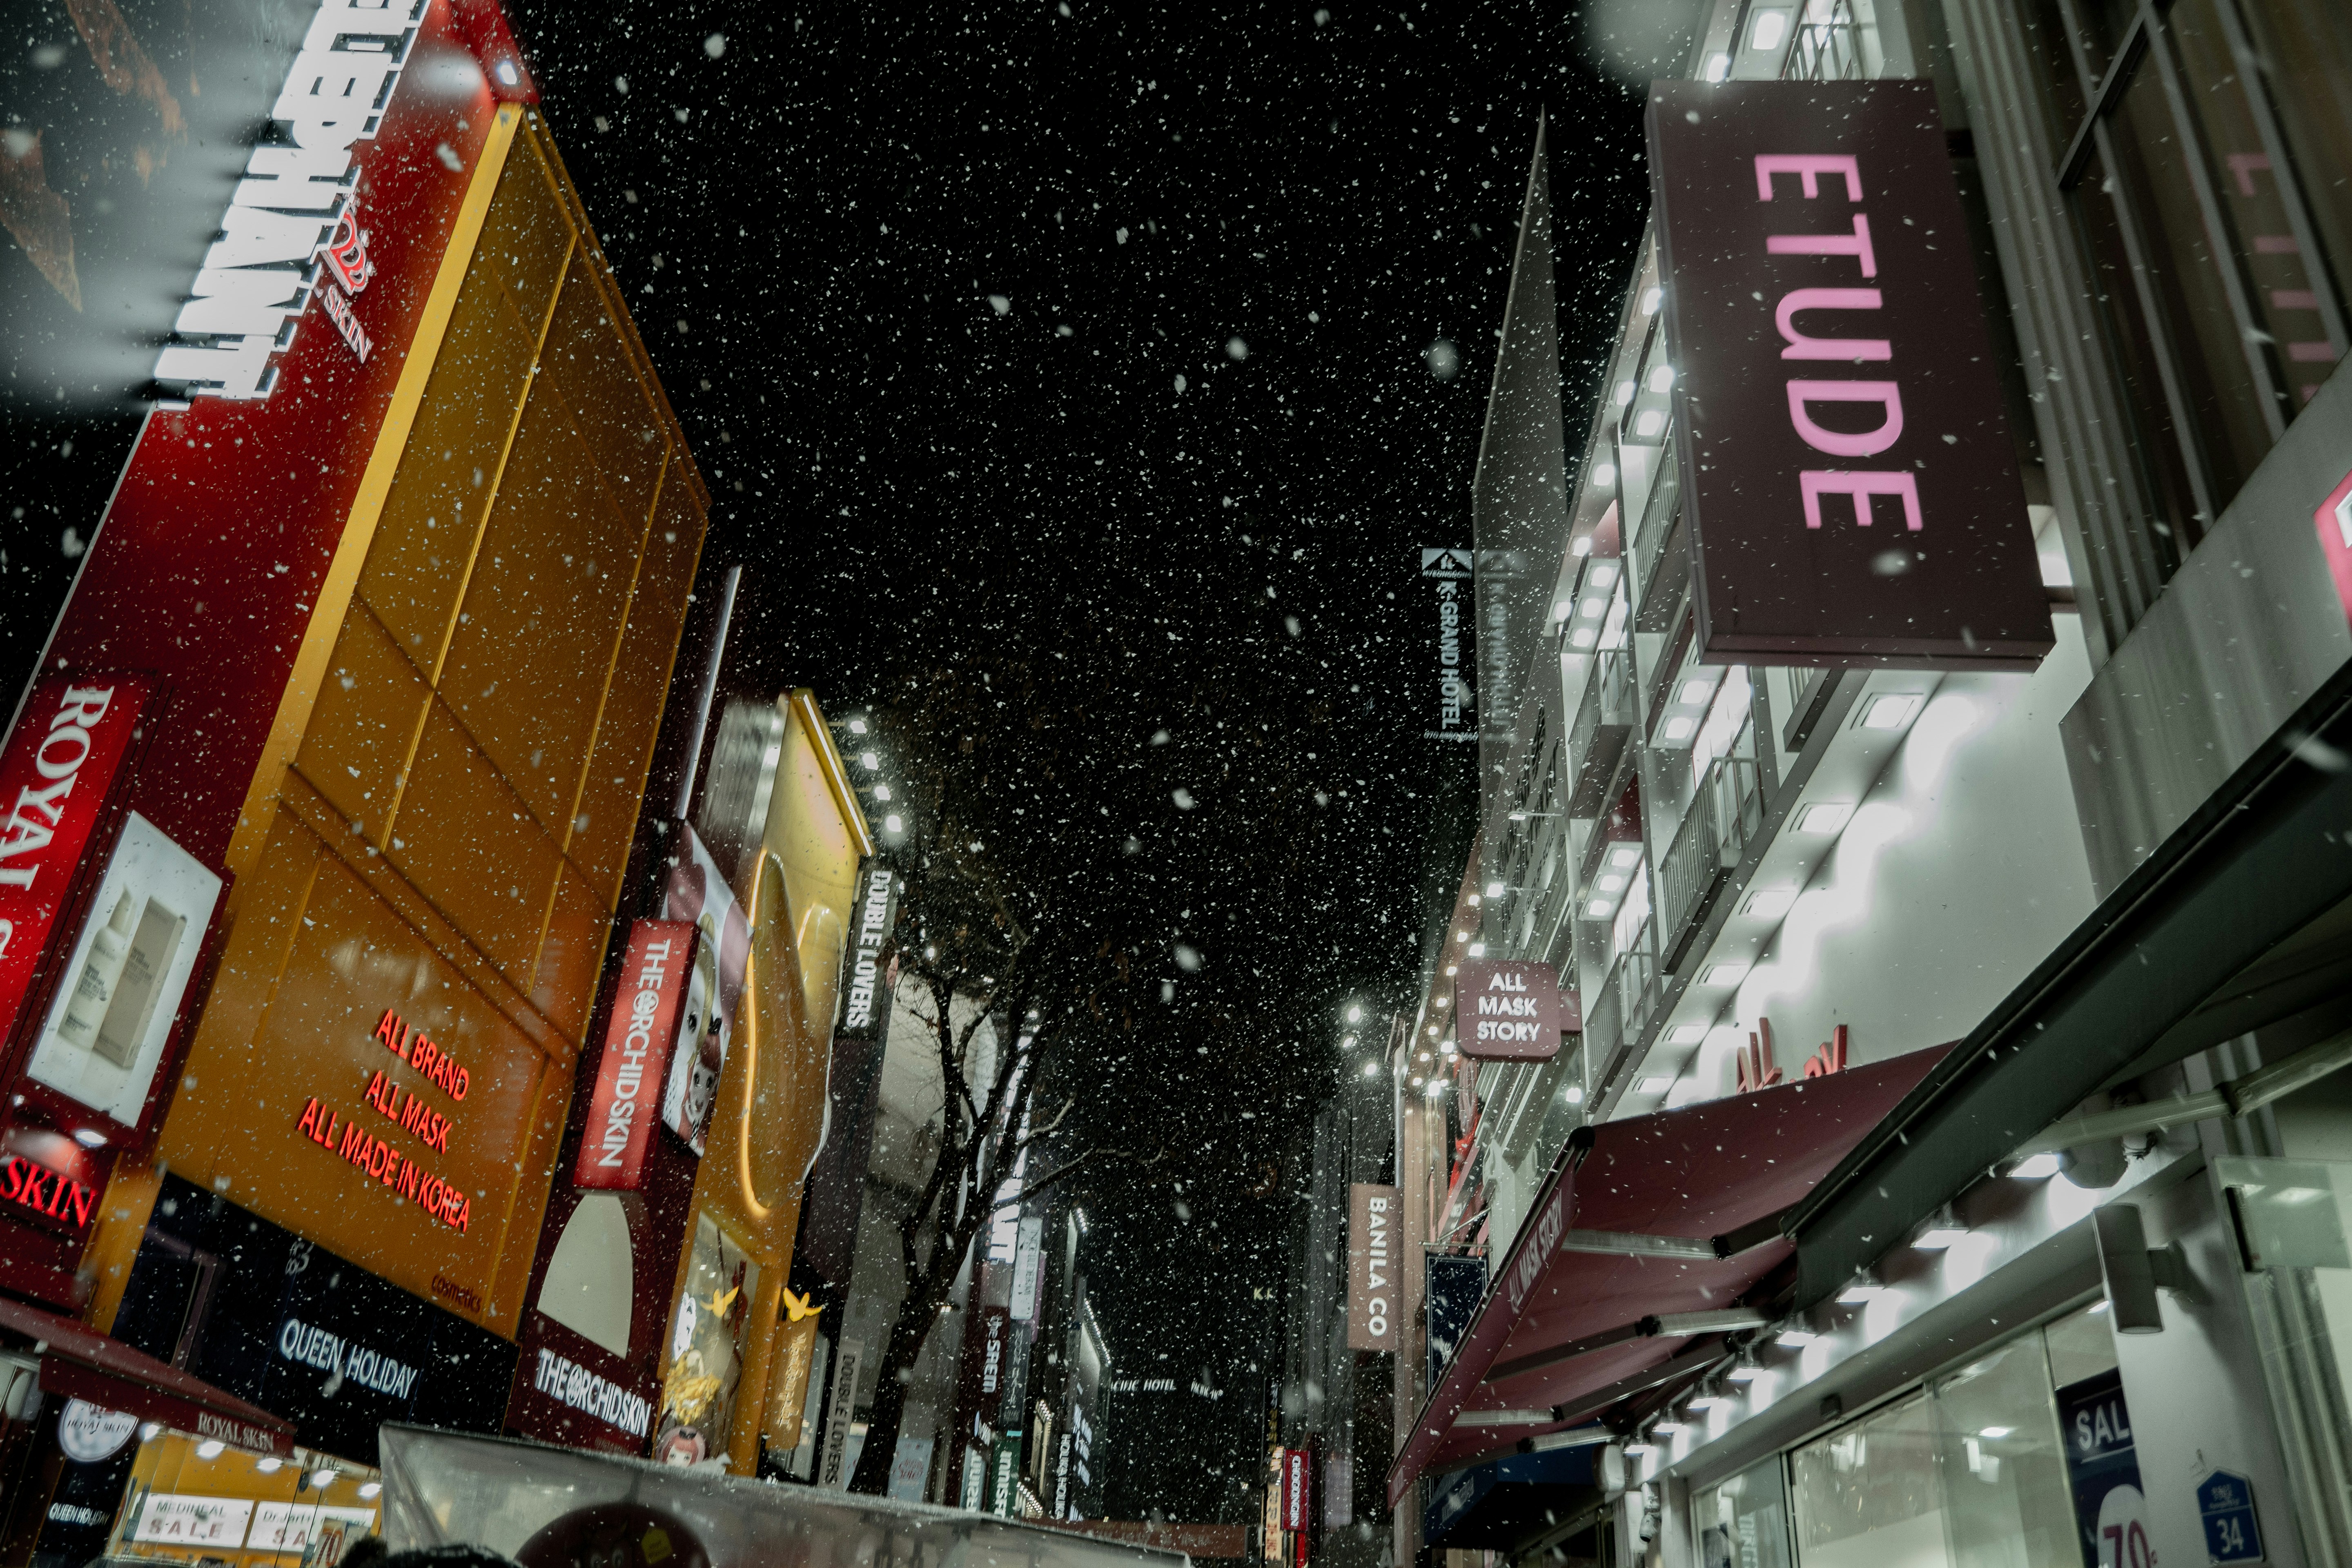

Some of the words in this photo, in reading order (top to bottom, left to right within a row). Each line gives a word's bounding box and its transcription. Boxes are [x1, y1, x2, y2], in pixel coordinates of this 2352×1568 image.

[153, 0, 430, 401] LEPHANT
[1754, 154, 1923, 532] ETUDE
[1439, 581, 1459, 666] K-GRAND
[1441, 668, 1461, 730] HOTEL
[860, 870, 892, 947] DOUBLE
[846, 949, 880, 1029] LOVERS
[1478, 996, 1537, 1017] MASK
[1488, 973, 1527, 992] ALL
[376, 1009, 408, 1060] ALL
[411, 1033, 469, 1101] BRAND
[1477, 1021, 1541, 1042] STORY
[365, 1071, 399, 1120] ALL
[401, 1094, 451, 1155] MASK
[0, 1156, 97, 1228] SKIN
[297, 1098, 337, 1150] ALL
[339, 1122, 399, 1186] MADE
[397, 1159, 419, 1200] IN
[417, 1175, 470, 1233] KOREA
[1369, 1196, 1388, 1290] BANILA
[432, 1275, 483, 1312] cosmetics
[1368, 1297, 1388, 1336] CO
[281, 1319, 344, 1373] QUEEN
[346, 1346, 417, 1399] HOLIDAY
[836, 1354, 855, 1417] DOUBLE
[1143, 1379, 1176, 1392] HOTEL
[198, 1412, 241, 1443] ROYAL
[243, 1428, 274, 1452] SKIN
[825, 1419, 844, 1485] LOVERS
[2076, 1400, 2132, 1452] SAL
[49, 1503, 78, 1523] QUEEN
[77, 1507, 109, 1526] HOLIDAY
[148, 1519, 225, 1539] SALE
[2216, 1517, 2244, 1555] 34
